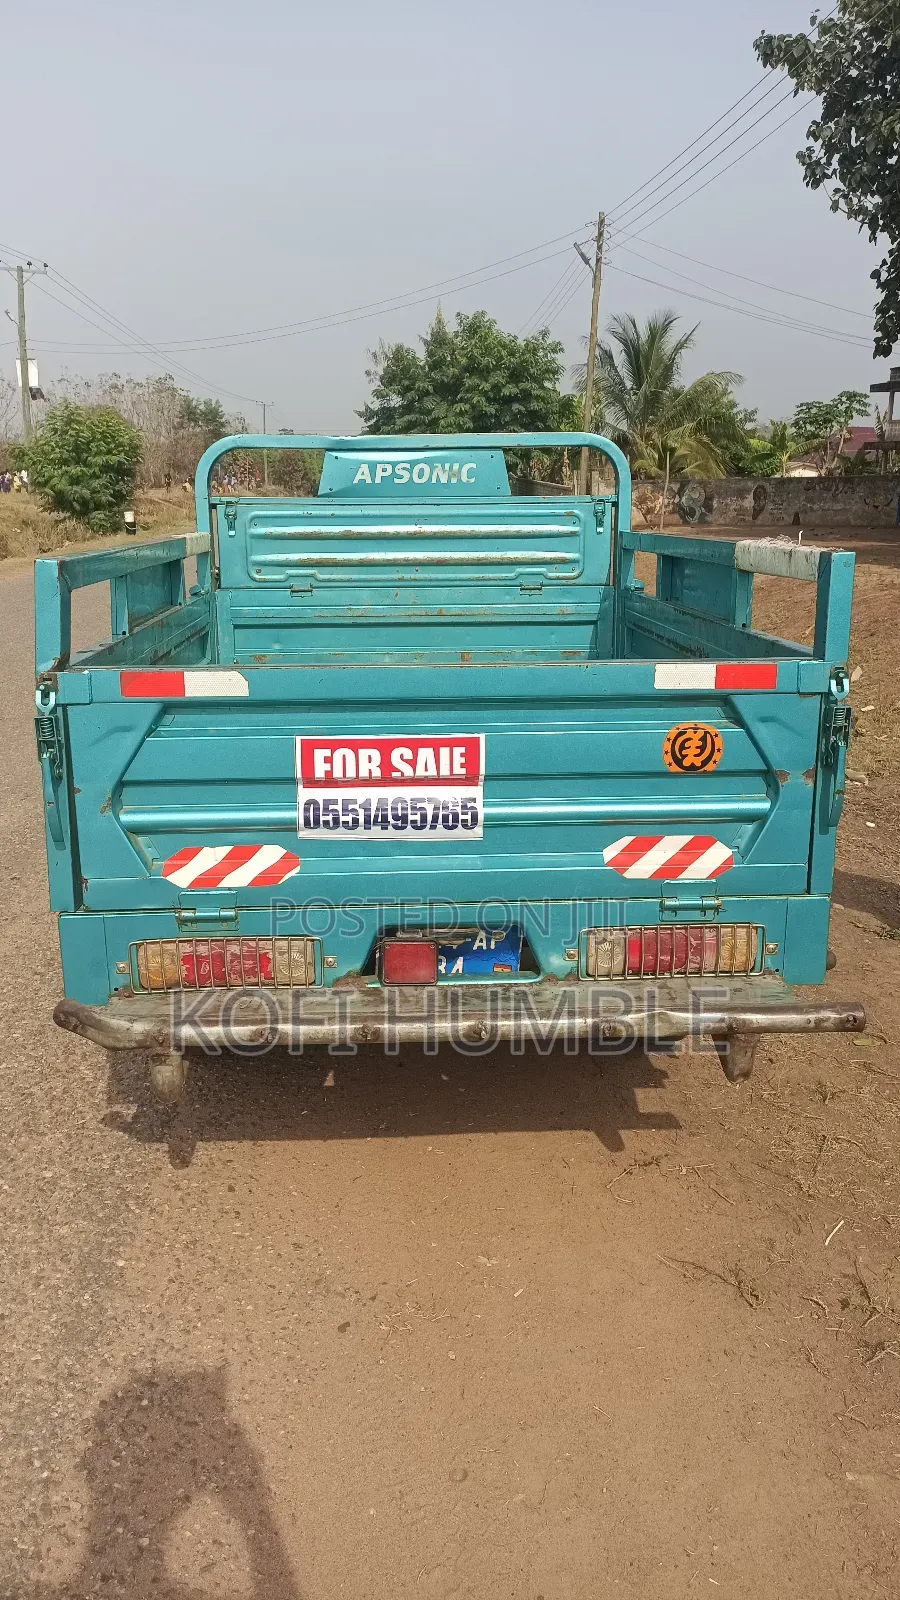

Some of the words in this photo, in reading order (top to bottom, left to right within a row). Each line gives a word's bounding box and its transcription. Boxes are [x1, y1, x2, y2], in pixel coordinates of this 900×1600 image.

[353, 463, 477, 484] APSONIC
[313, 747, 382, 780] FOR
[390, 746, 467, 779] SALE
[303, 797, 479, 831] 0551495765
